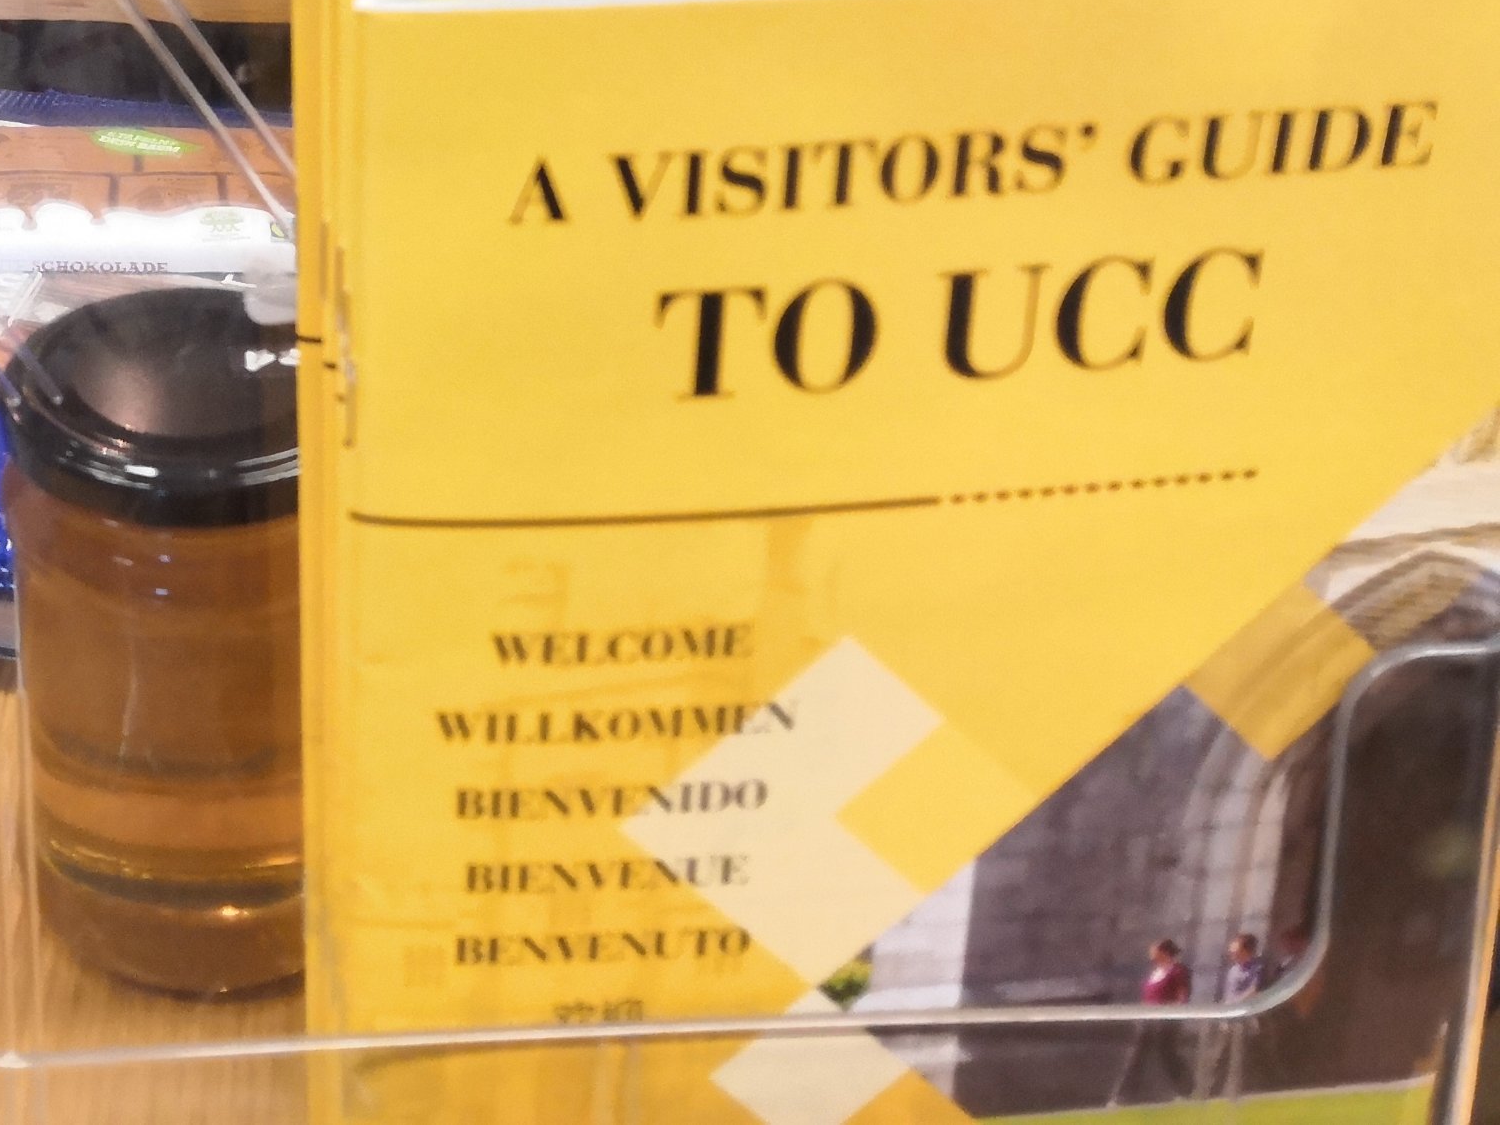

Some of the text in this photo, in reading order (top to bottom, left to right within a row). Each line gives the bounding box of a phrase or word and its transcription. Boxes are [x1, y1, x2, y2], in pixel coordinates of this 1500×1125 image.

[508, 155, 573, 225] A
[1127, 99, 1442, 188] GUIDE
[653, 245, 1266, 403] TO UCC
[490, 623, 755, 667] WELCOME
[434, 699, 798, 744] WILLKOMMEN
[455, 778, 769, 821] BIENVENIDO
[465, 854, 751, 895] BIENVENUE
[455, 925, 752, 967] BENVENUTO
